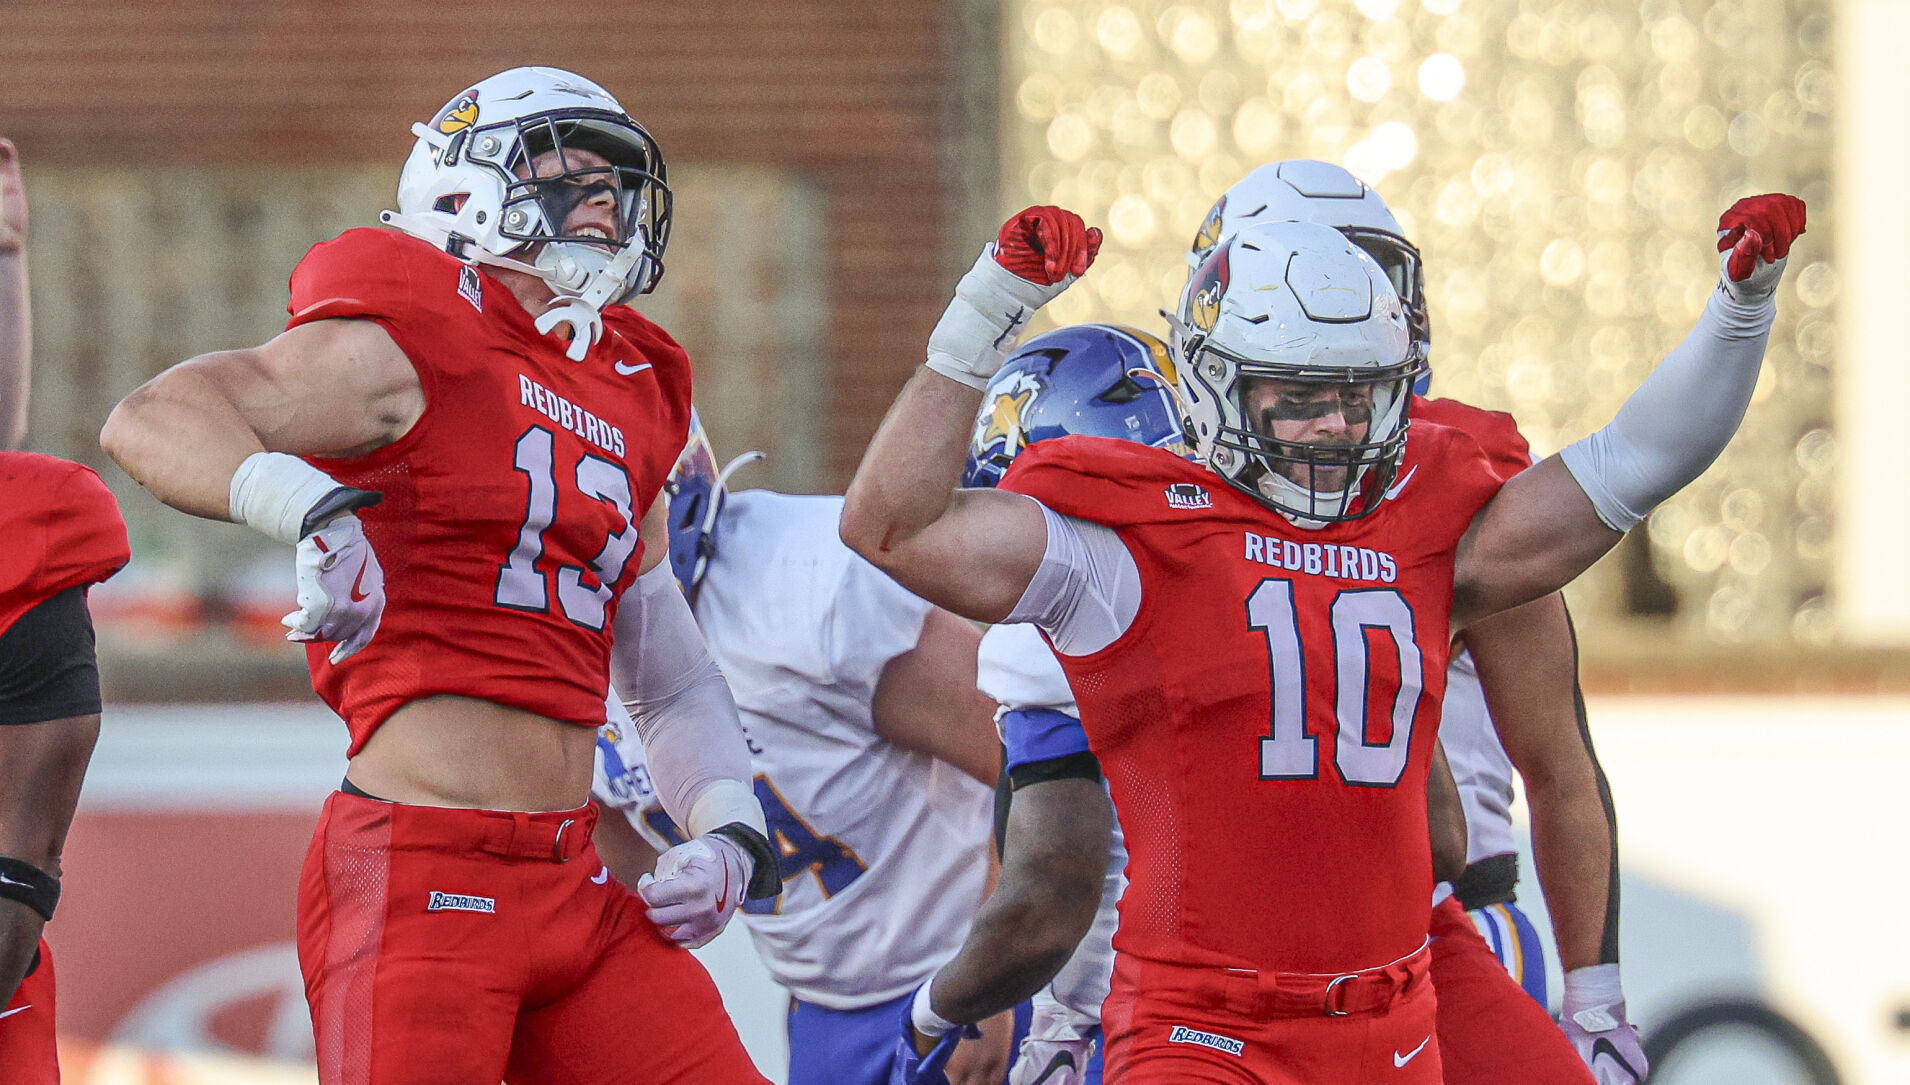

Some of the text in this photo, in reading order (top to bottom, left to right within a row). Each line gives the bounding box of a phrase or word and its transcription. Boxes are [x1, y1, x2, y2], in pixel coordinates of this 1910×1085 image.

[518, 373, 625, 459] REDBIRDS
[1164, 490, 1210, 506] VALLEY
[494, 424, 638, 633] 13
[1244, 531, 1398, 583] REDBIRDS
[1245, 577, 1424, 788] 10
[430, 893, 493, 911] REDBIRDS
[1172, 1027, 1242, 1053] REDBIRDS
